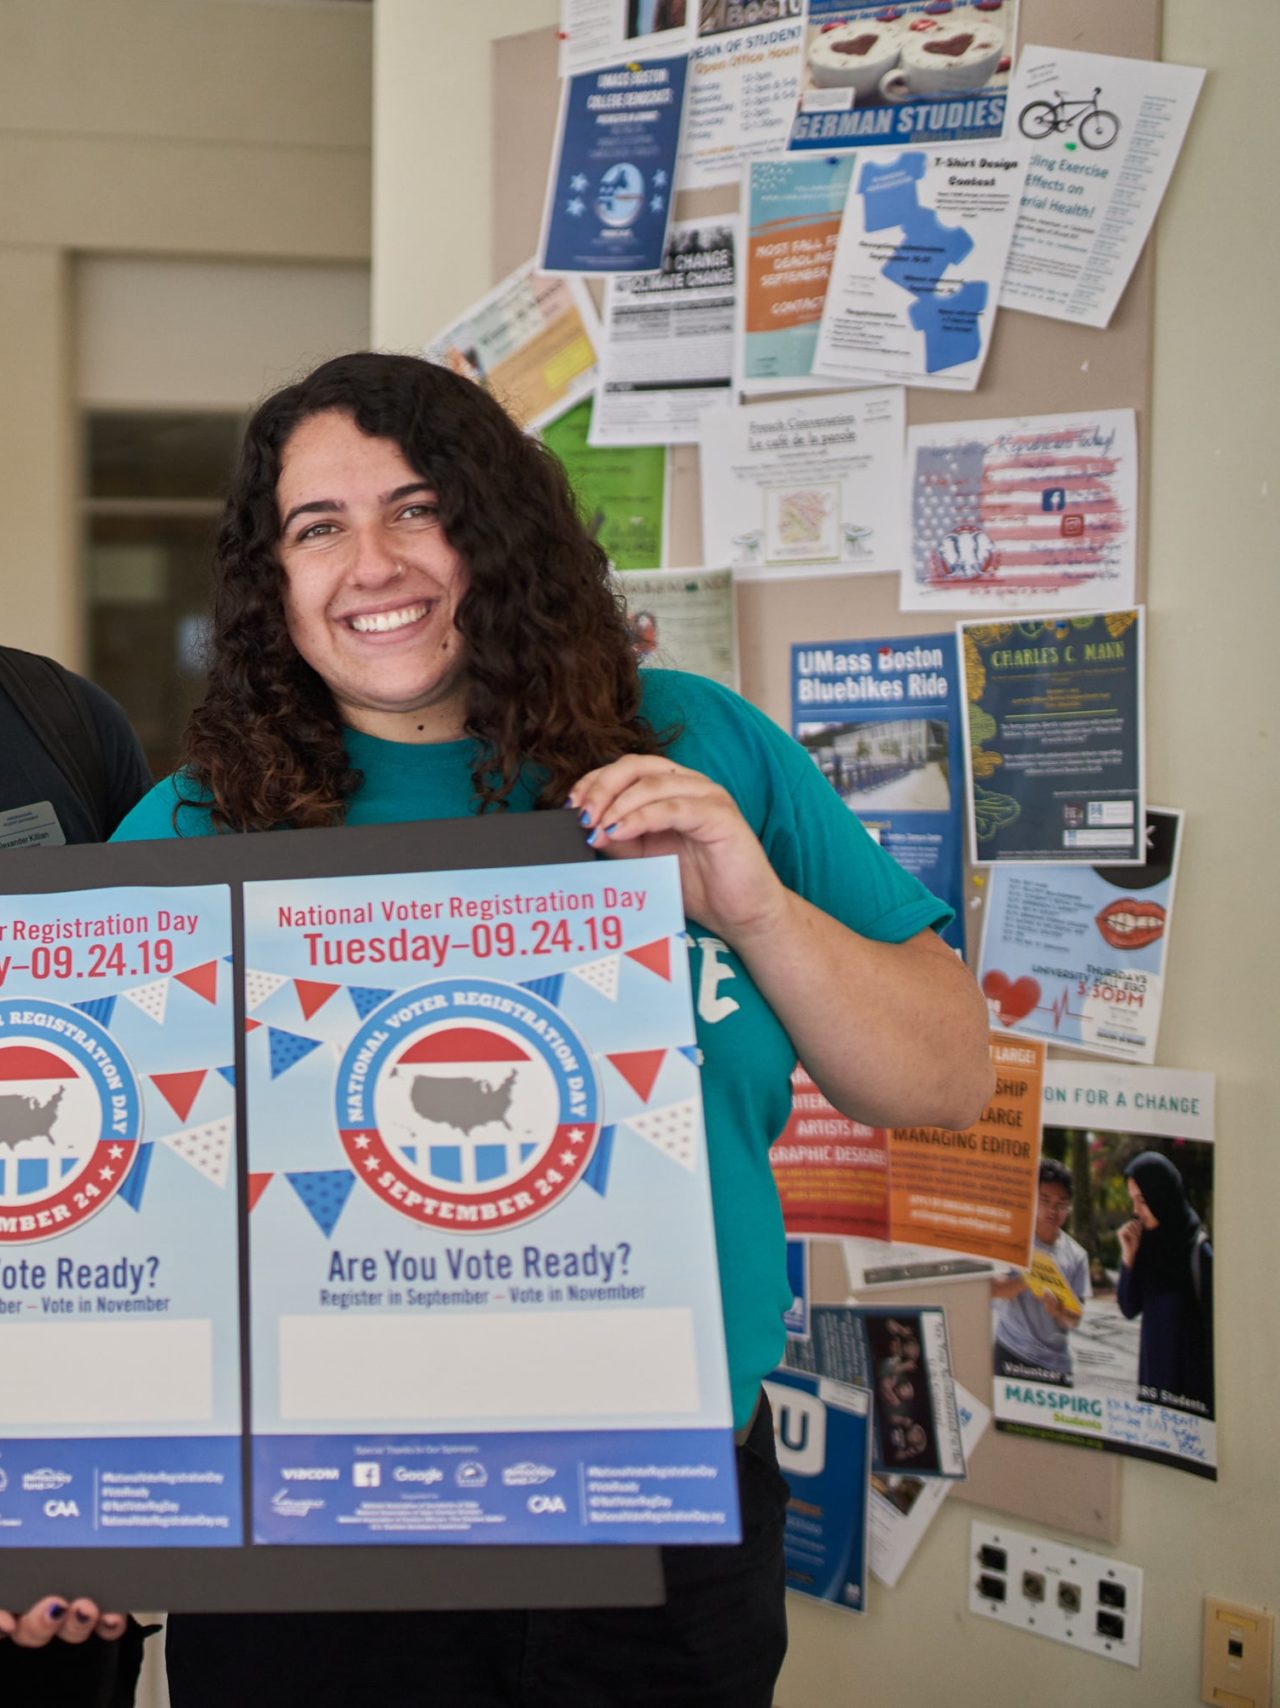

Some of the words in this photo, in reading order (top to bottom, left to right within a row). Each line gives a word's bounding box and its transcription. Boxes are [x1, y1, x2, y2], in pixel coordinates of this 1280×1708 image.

[792, 107, 895, 141] GERMAN
[897, 98, 1006, 134] STUDIES
[935, 157, 976, 168] T-Shirt
[1058, 159, 1109, 178] Exercise
[1067, 185, 1084, 195] on
[797, 650, 871, 675] UMass
[877, 646, 944, 671] Boston
[797, 676, 904, 703] Bluebikes
[908, 672, 948, 699] Ride
[278, 902, 373, 927] National
[381, 901, 443, 922] Voter
[448, 892, 595, 922] Registration
[603, 886, 647, 913] Day
[12, 914, 150, 944] Registration
[157, 910, 199, 936] Day
[348, 1030, 391, 1124] NATIONAL
[389, 993, 449, 1030] VOTER
[452, 990, 580, 1081] REGISTRATION
[568, 1075, 587, 1118] DAY
[9, 1011, 123, 1092] REGISTRATION
[112, 1095, 127, 1135] DAY
[1074, 1089, 1109, 1106] FOR
[1115, 1091, 1127, 1106] A
[1134, 1093, 1200, 1115] CHANGE
[979, 1109, 1023, 1127] LARGE
[768, 1145, 833, 1162] GRAPHIC
[893, 1128, 977, 1150] MANAGING
[982, 1135, 1031, 1158] EDITOR
[74, 1182, 103, 1210] 24
[376, 1169, 535, 1222] SEPTEMBER
[534, 1167, 565, 1197] 24
[56, 1255, 160, 1296] Ready?
[328, 1250, 377, 1282] Are
[384, 1249, 437, 1281] You
[446, 1247, 512, 1280] Vote
[523, 1242, 632, 1284] Ready?
[40, 1297, 75, 1314] Vote
[79, 1296, 93, 1313] in
[96, 1295, 170, 1312] November
[1004, 1361, 1061, 1380] Volunteer
[1005, 1384, 1103, 1417] MASSPIRG
[1053, 1412, 1102, 1430] Students
[394, 1465, 444, 1485] Google
[44, 1500, 79, 1517] CAA
